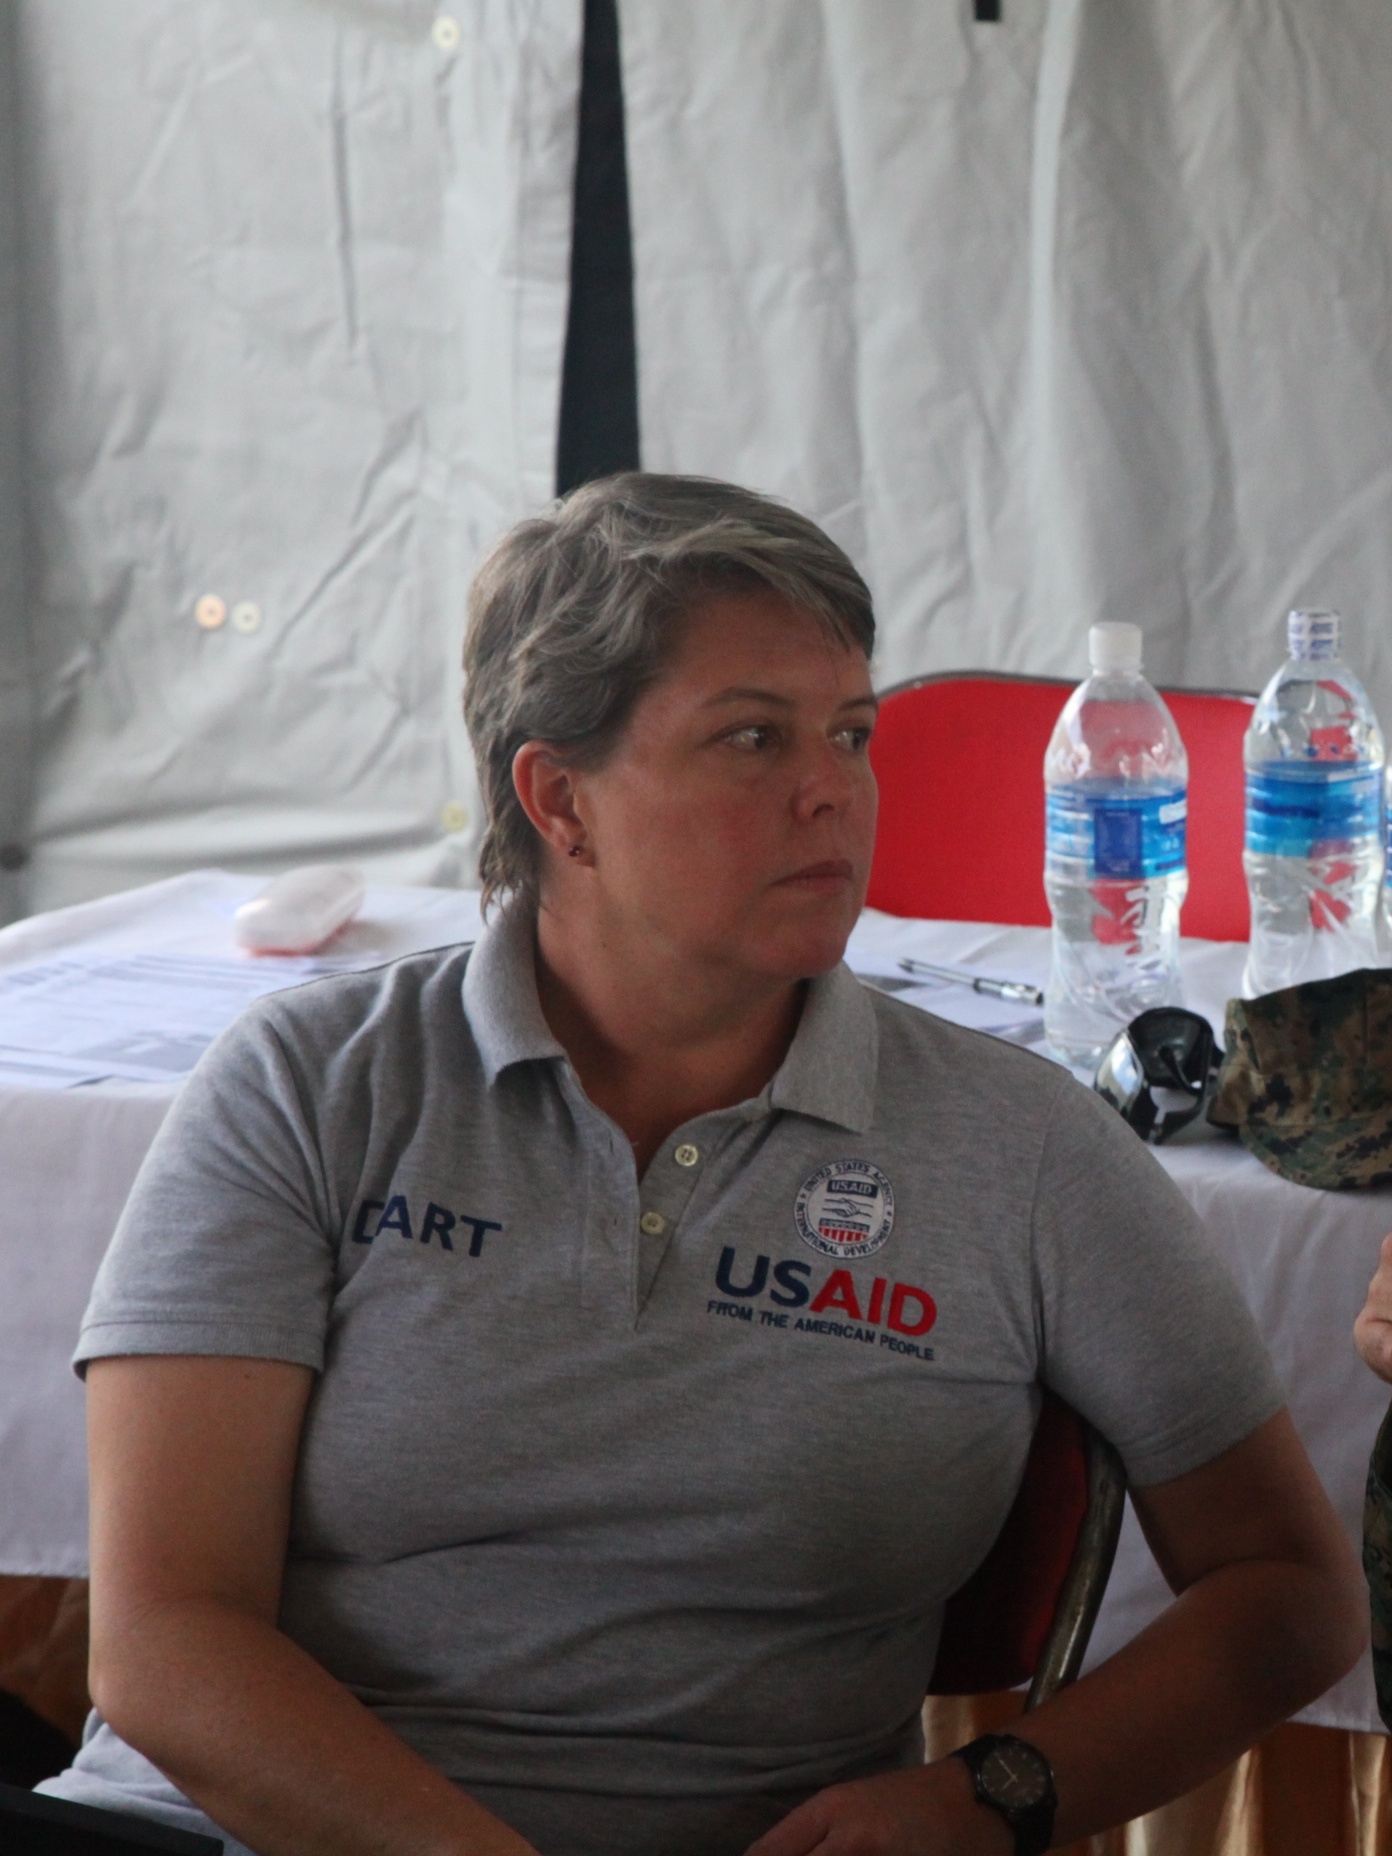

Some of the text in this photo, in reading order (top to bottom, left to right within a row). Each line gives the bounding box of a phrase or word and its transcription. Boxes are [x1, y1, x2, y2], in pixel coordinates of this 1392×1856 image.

[831, 1180, 872, 1195] USAID
[715, 1247, 938, 1337] USAID
[707, 1299, 935, 1361] FROM THE AMERICAN PEOPLE
